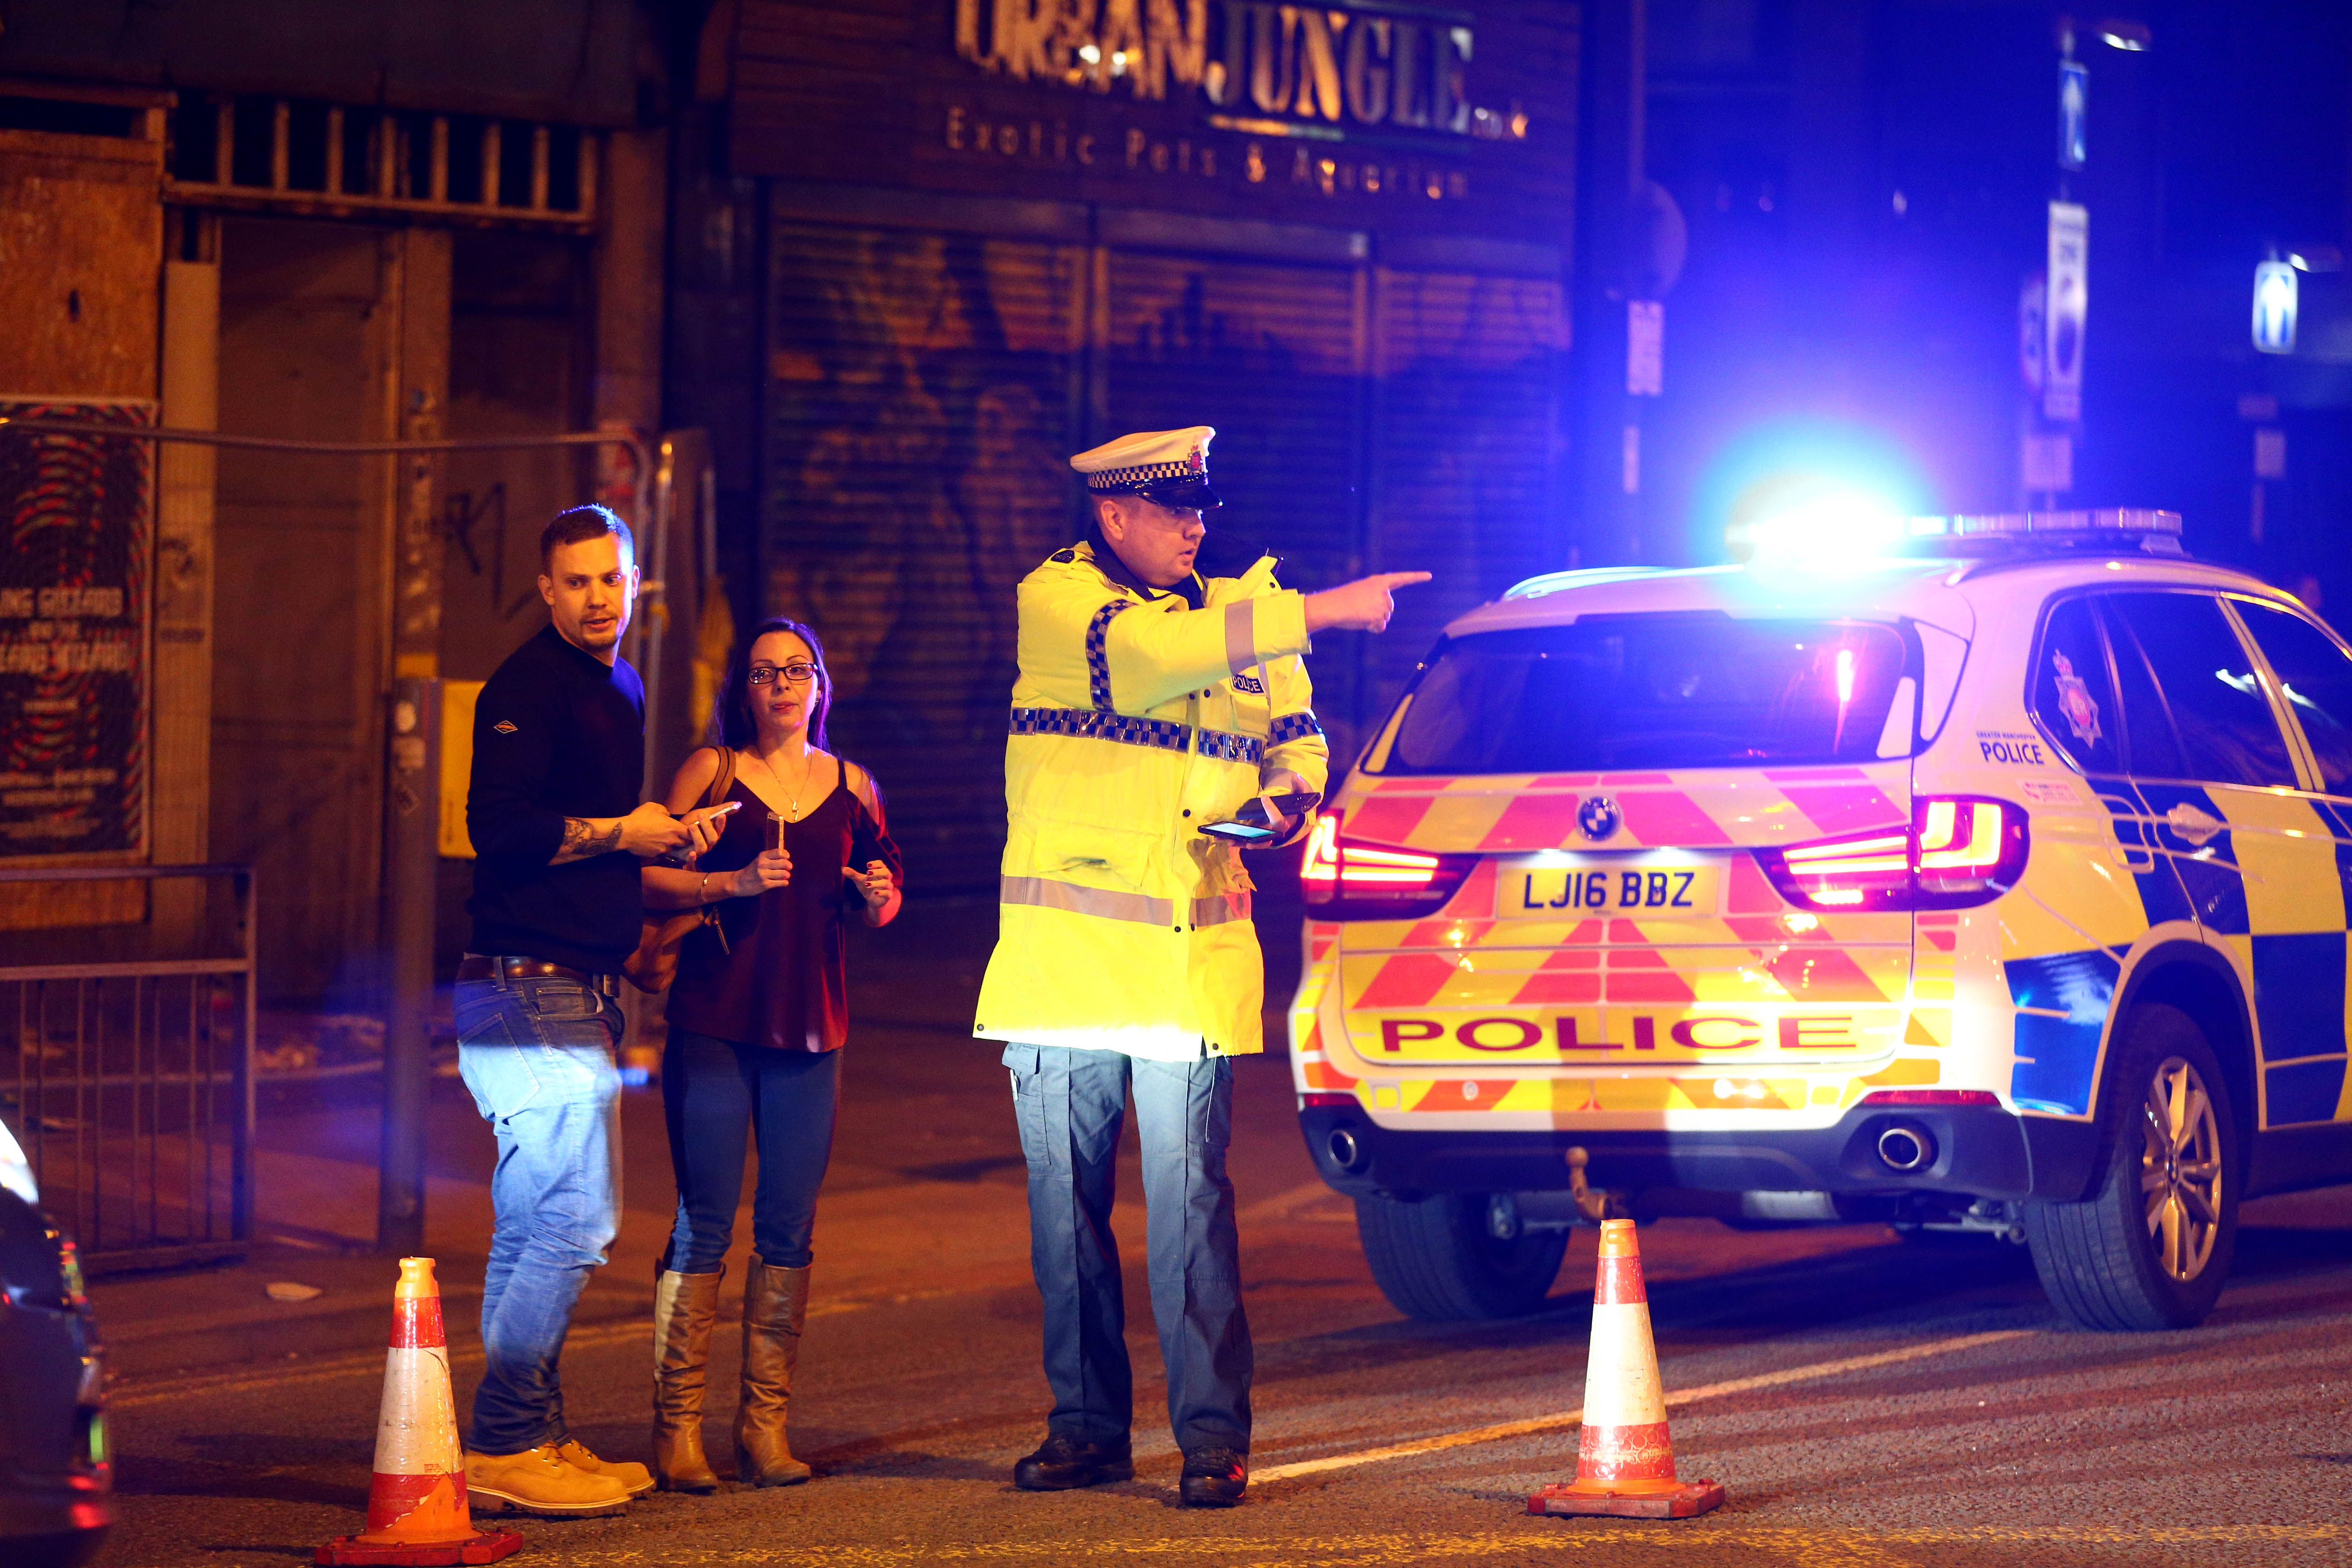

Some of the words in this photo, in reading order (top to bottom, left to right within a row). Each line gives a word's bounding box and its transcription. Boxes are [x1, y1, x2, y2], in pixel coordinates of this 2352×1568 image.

[1205, 0, 1473, 134] JUNGLE
[1232, 675, 1261, 692] POLICE
[1980, 741, 2044, 764] POLICE
[1524, 872, 1607, 908] LJ16
[1618, 872, 1695, 907] BBZ
[1381, 1016, 1857, 1052] POLICE
